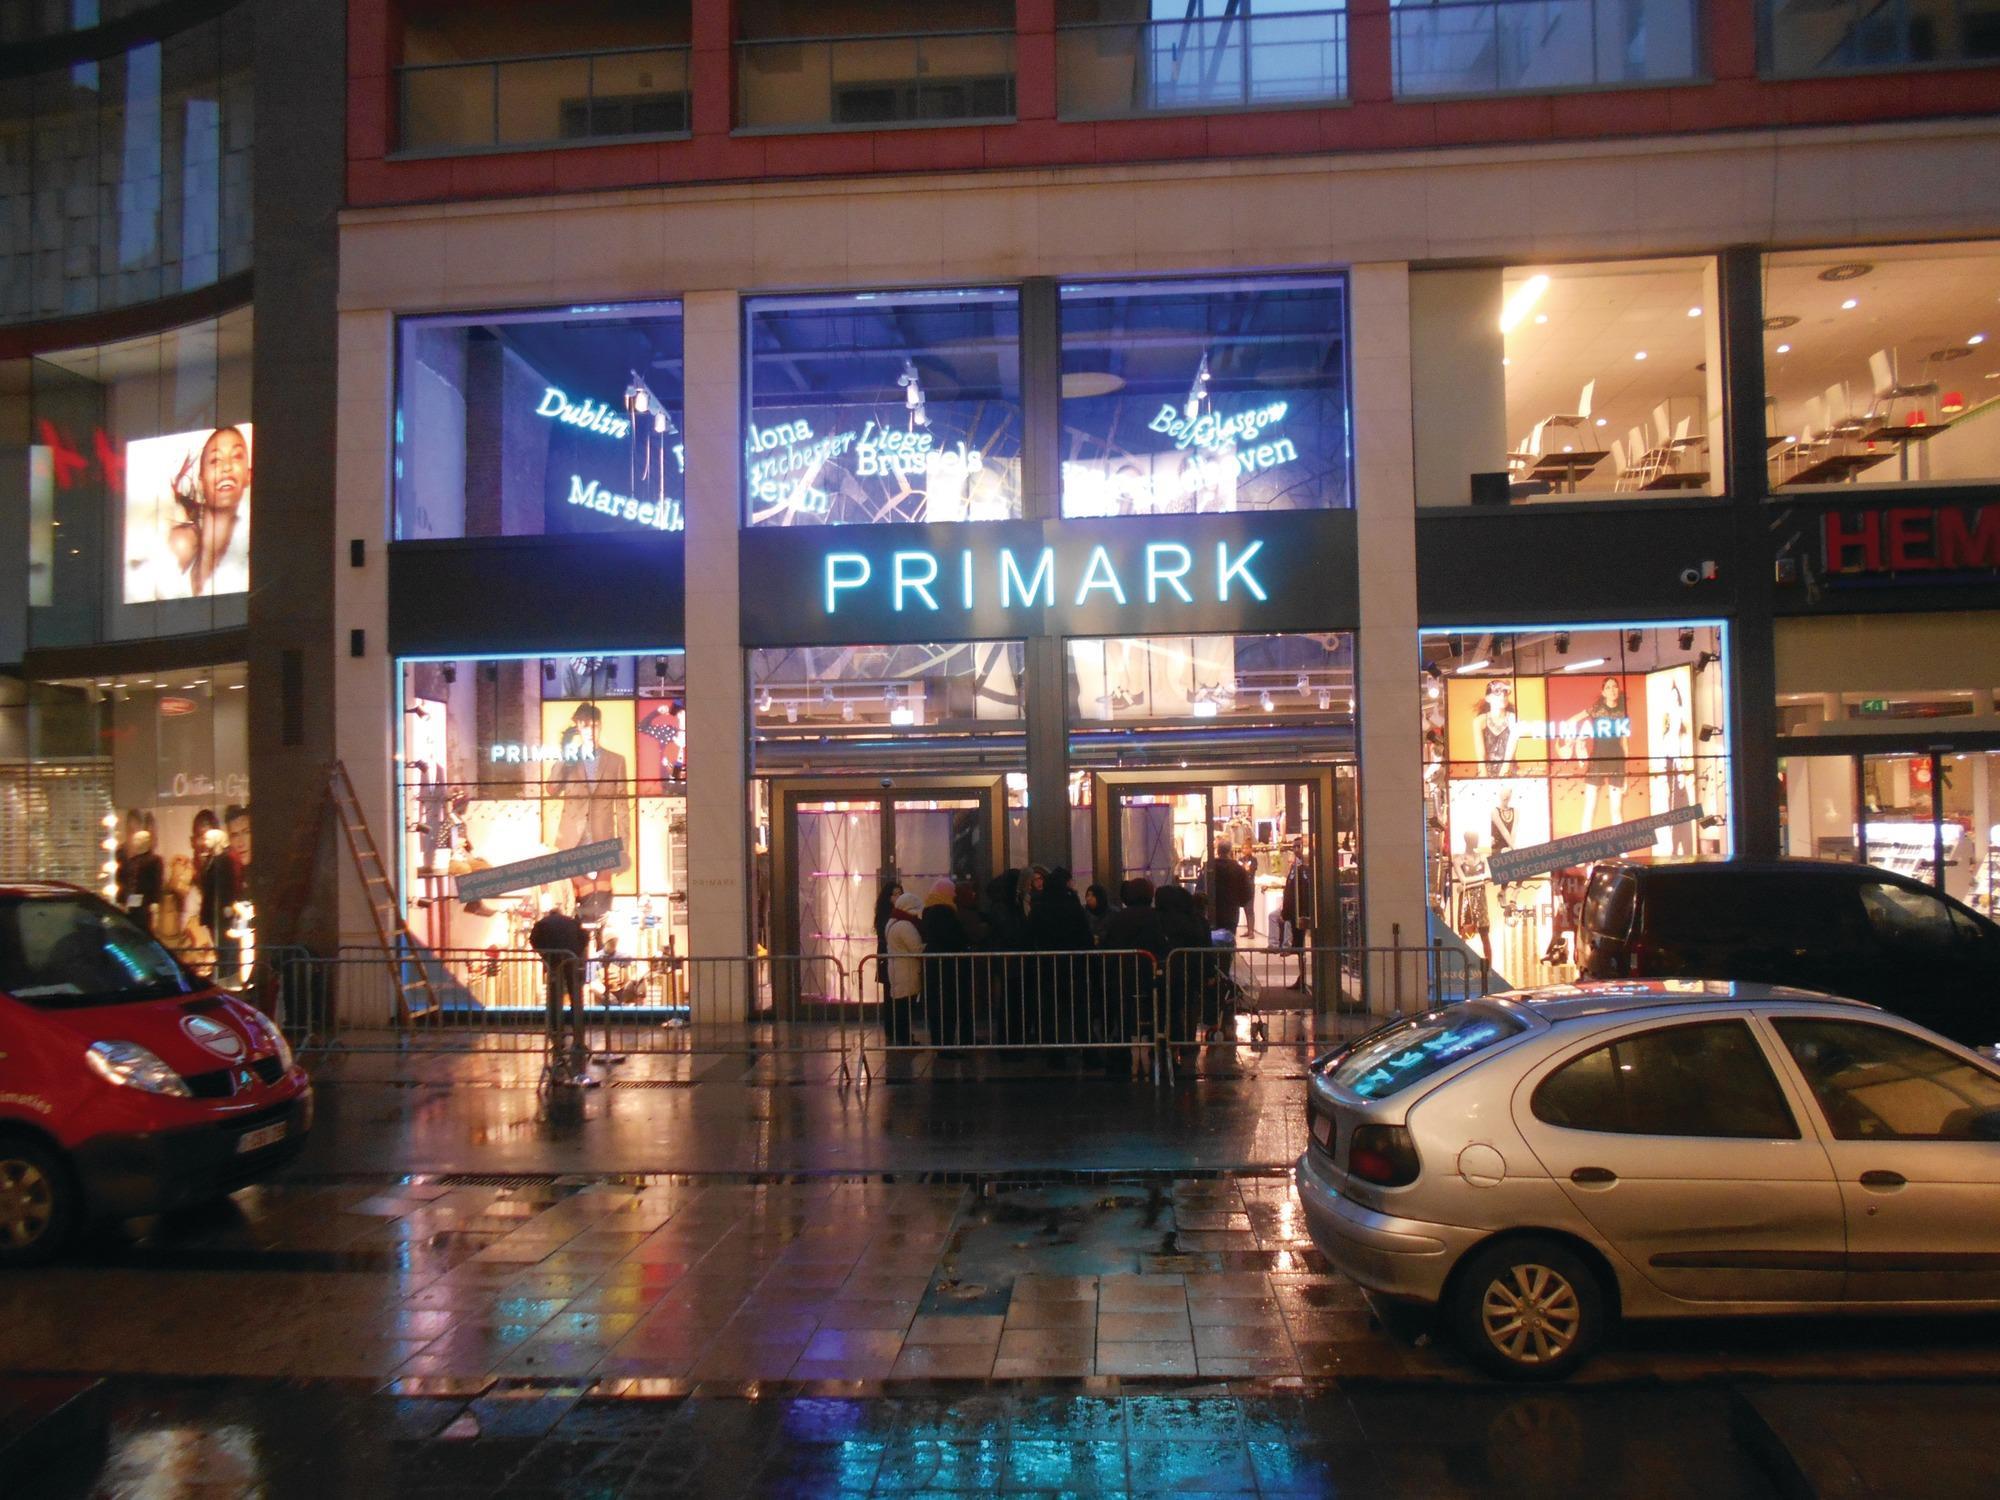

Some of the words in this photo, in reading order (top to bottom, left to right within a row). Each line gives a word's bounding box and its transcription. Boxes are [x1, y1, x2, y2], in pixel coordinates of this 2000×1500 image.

[536, 387, 631, 439] Dublin
[857, 421, 933, 450] Liege
[1193, 400, 1289, 446] Glasgow
[856, 441, 982, 476] Brussels
[567, 474, 684, 531] Marseill
[1822, 502, 2000, 573] HEM
[824, 539, 1269, 614] PRIMARK
[1575, 846, 1603, 861] 2014
